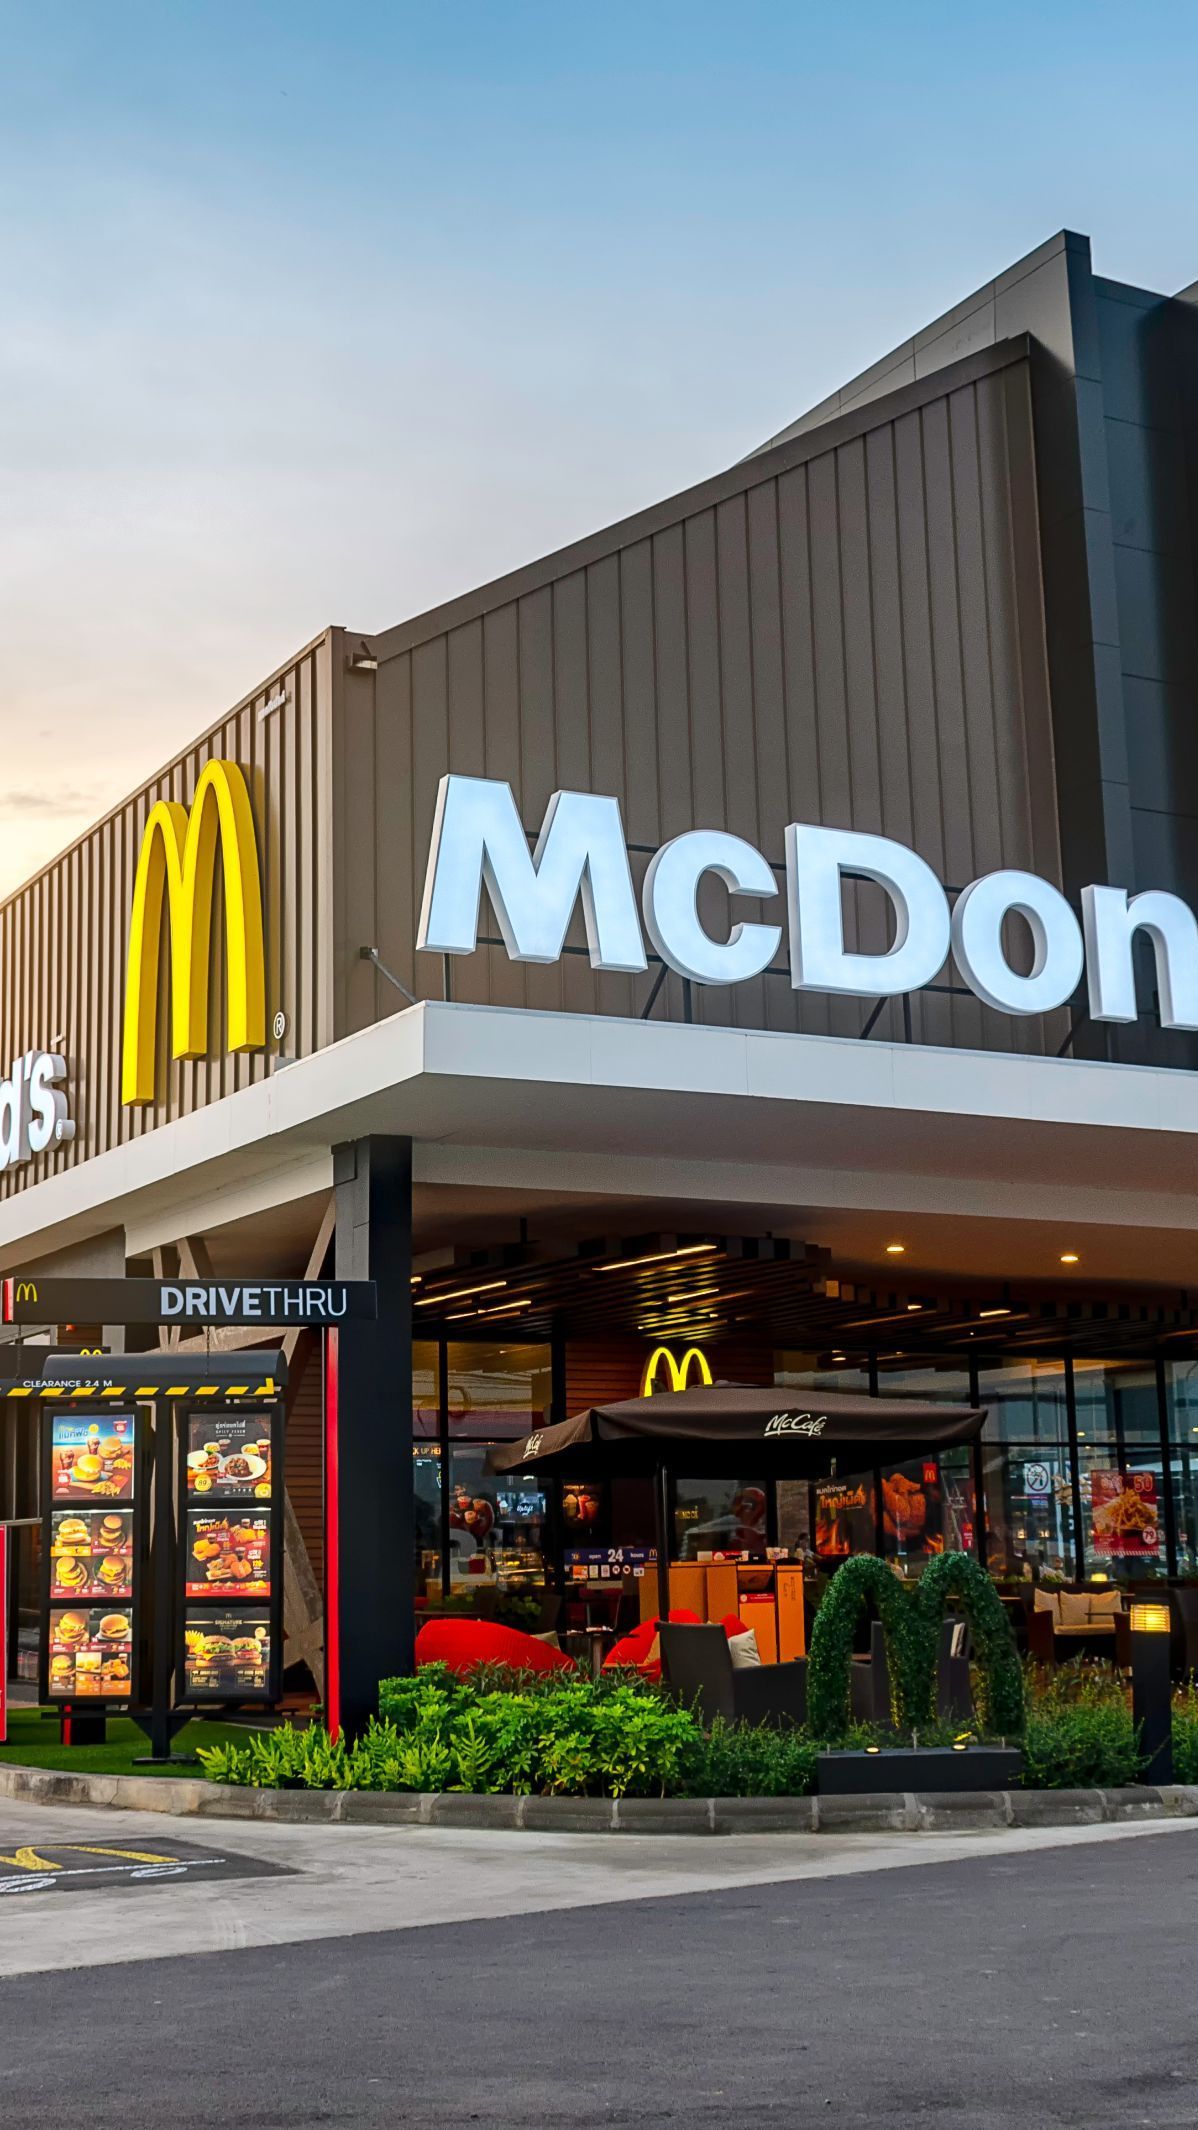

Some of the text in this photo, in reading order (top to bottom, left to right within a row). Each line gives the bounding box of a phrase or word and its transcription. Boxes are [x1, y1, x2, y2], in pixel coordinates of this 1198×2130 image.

[416, 773, 1198, 1030] McDon
[22, 1380, 81, 1388] CLEARANCE
[764, 1413, 827, 1437] McCafé
[608, 1549, 624, 1562] 24
